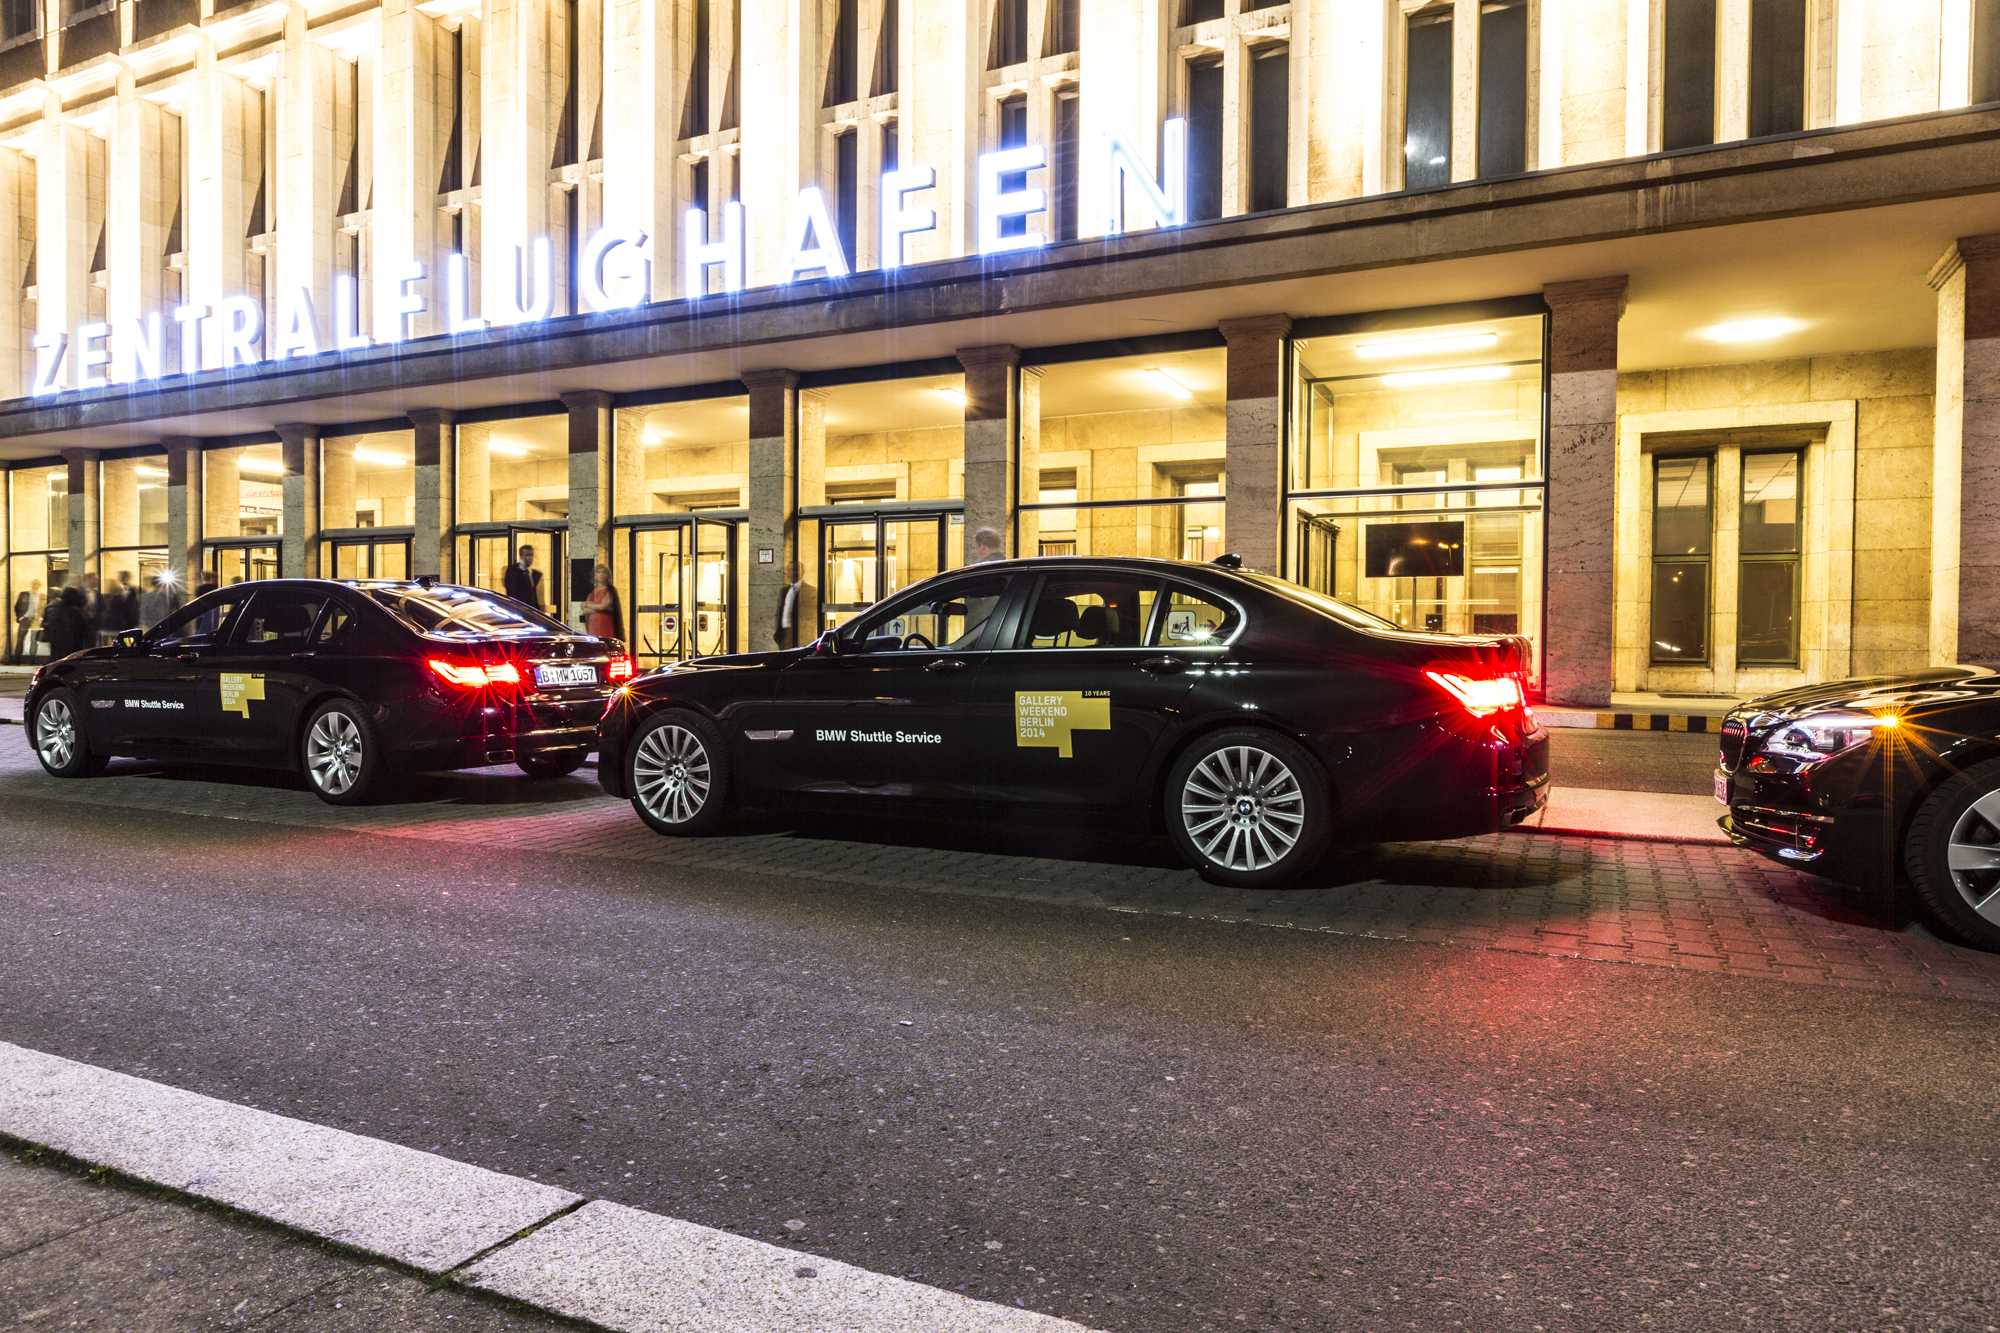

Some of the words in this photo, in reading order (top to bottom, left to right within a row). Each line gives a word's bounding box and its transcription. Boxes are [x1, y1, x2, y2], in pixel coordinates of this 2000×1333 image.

[31, 117, 1189, 398] ZENTRALFLUGHAFEN
[542, 670, 550, 683] B
[125, 699, 140, 708] BMW
[161, 700, 185, 709] Service
[1019, 695, 1063, 706] GALLERY
[1019, 706, 1067, 717] WEEKEND
[1019, 717, 1054, 727] BERLIN
[816, 729, 847, 742] BMW
[850, 730, 893, 743] Shuttle
[895, 731, 942, 744] Service
[1020, 727, 1045, 738] 2014
